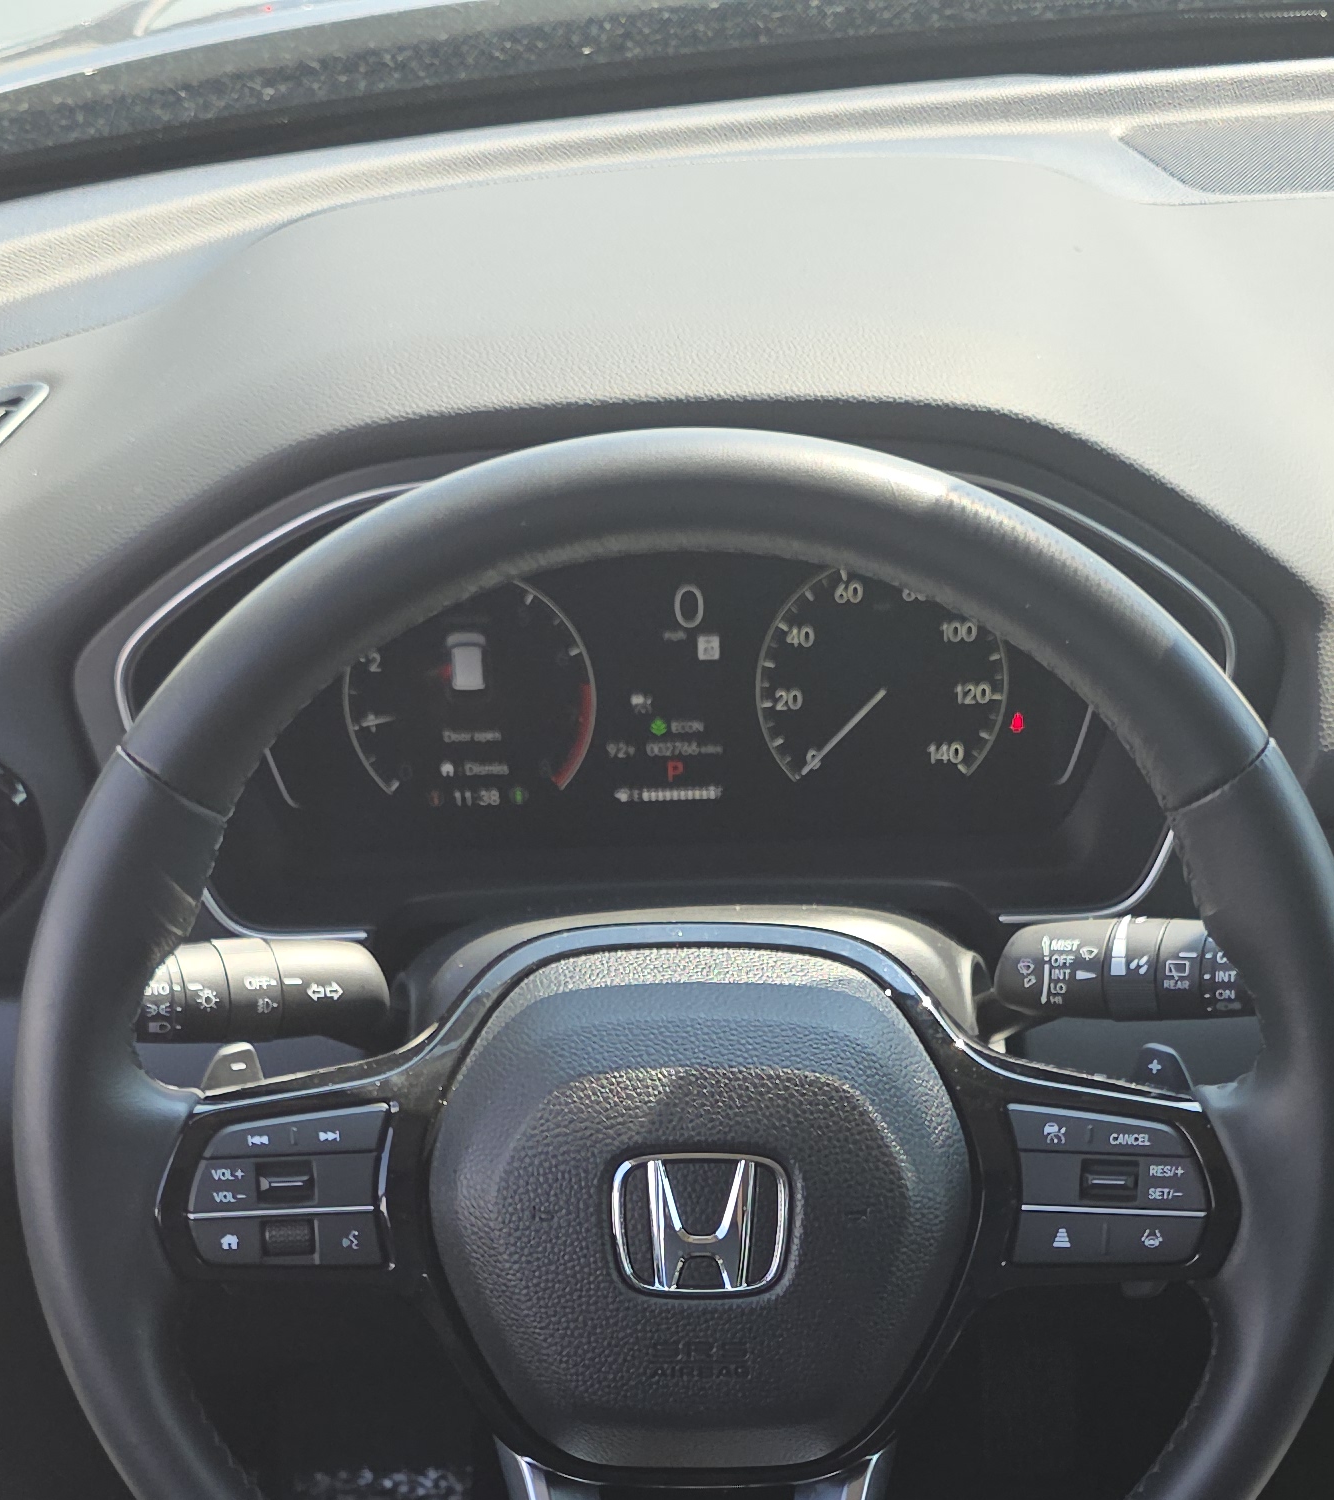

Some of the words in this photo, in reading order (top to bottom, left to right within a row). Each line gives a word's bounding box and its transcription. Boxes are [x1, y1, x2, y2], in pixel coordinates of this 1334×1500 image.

[834, 580, 864, 604] 60
[674, 583, 704, 628] 0
[787, 624, 815, 648] 40
[940, 620, 978, 643] 100
[369, 651, 381, 672] 2
[775, 688, 803, 711] 20
[954, 682, 992, 705] 120
[927, 741, 965, 764] 140
[668, 761, 683, 782] P
[1050, 939, 1081, 952] MIST
[1051, 955, 1075, 967] OFF
[1051, 968, 1071, 980] INT
[1215, 970, 1237, 982] INT
[1050, 983, 1067, 994] LO
[1163, 980, 1190, 990] REAR
[1215, 989, 1236, 1000] ON
[1109, 1132, 1152, 1147] CANCEL
[211, 1168, 246, 1181] VOL+
[1149, 1164, 1185, 1178] RES/+
